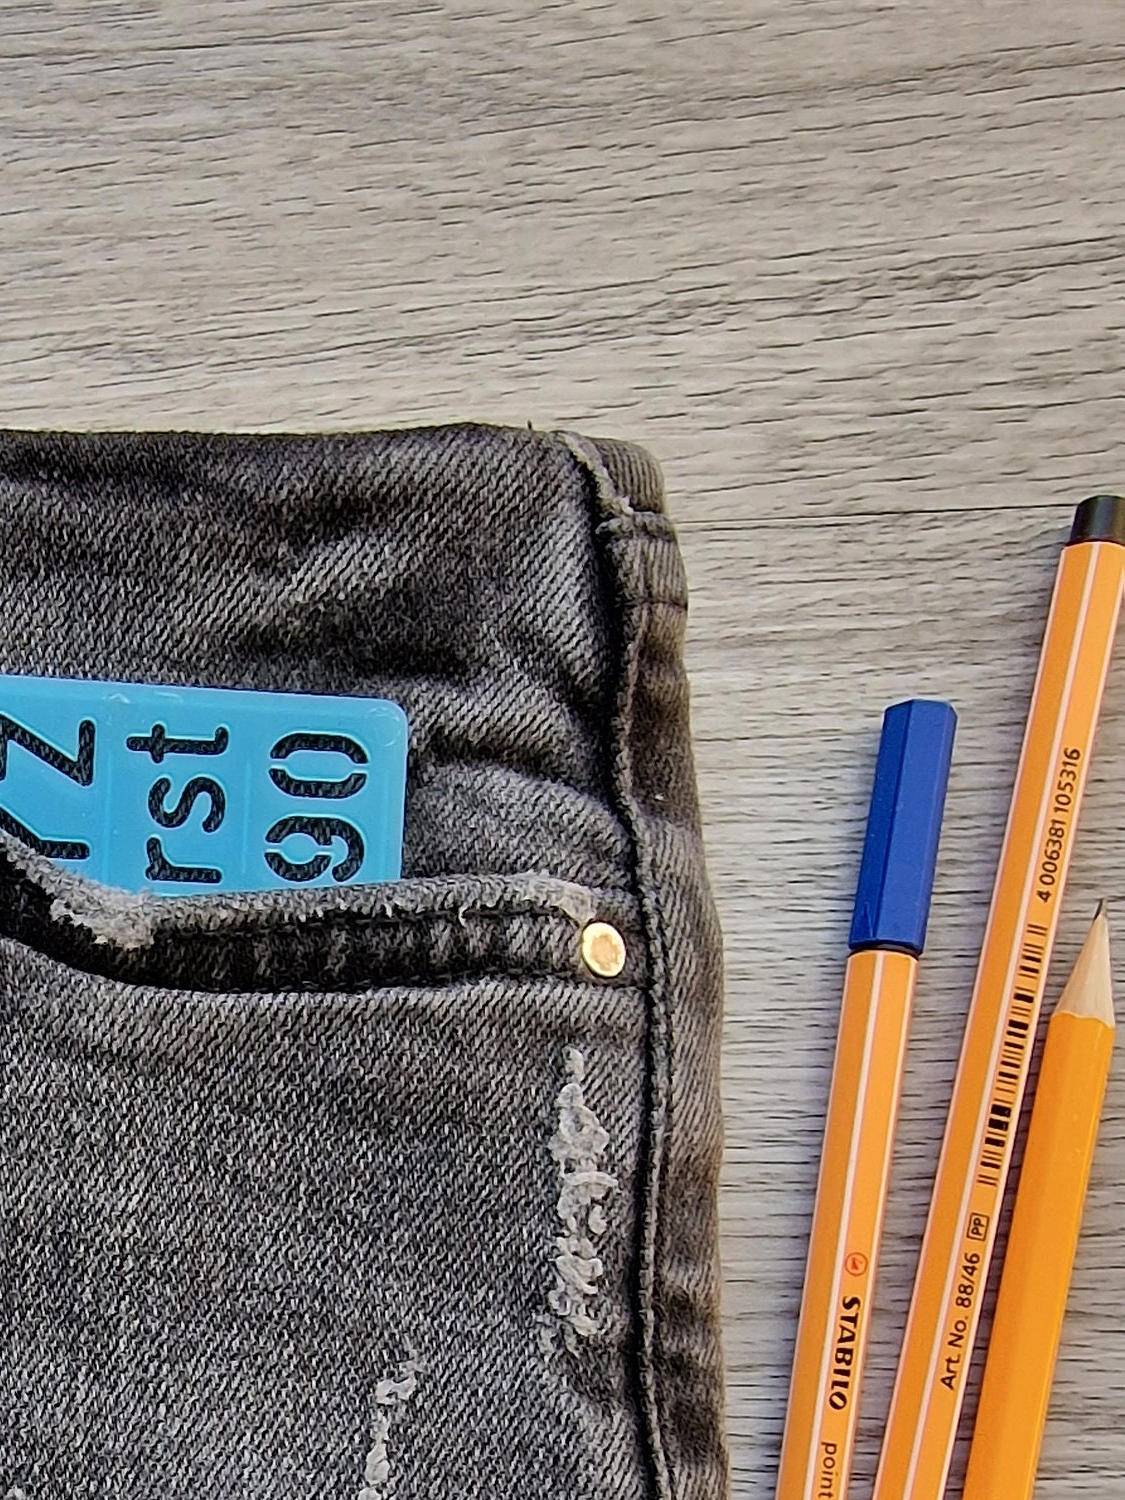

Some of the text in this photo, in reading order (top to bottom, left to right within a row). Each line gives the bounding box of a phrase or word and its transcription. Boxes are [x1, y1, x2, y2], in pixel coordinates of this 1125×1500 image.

[126, 722, 230, 884] rst
[264, 732, 369, 883] 90
[1037, 748, 1081, 903] 4 006381 105316
[970, 1217, 986, 1236] PP
[828, 1295, 862, 1411] STABILO
[941, 1252, 981, 1391] Art. No. 88/46
[817, 1441, 839, 1499] point
